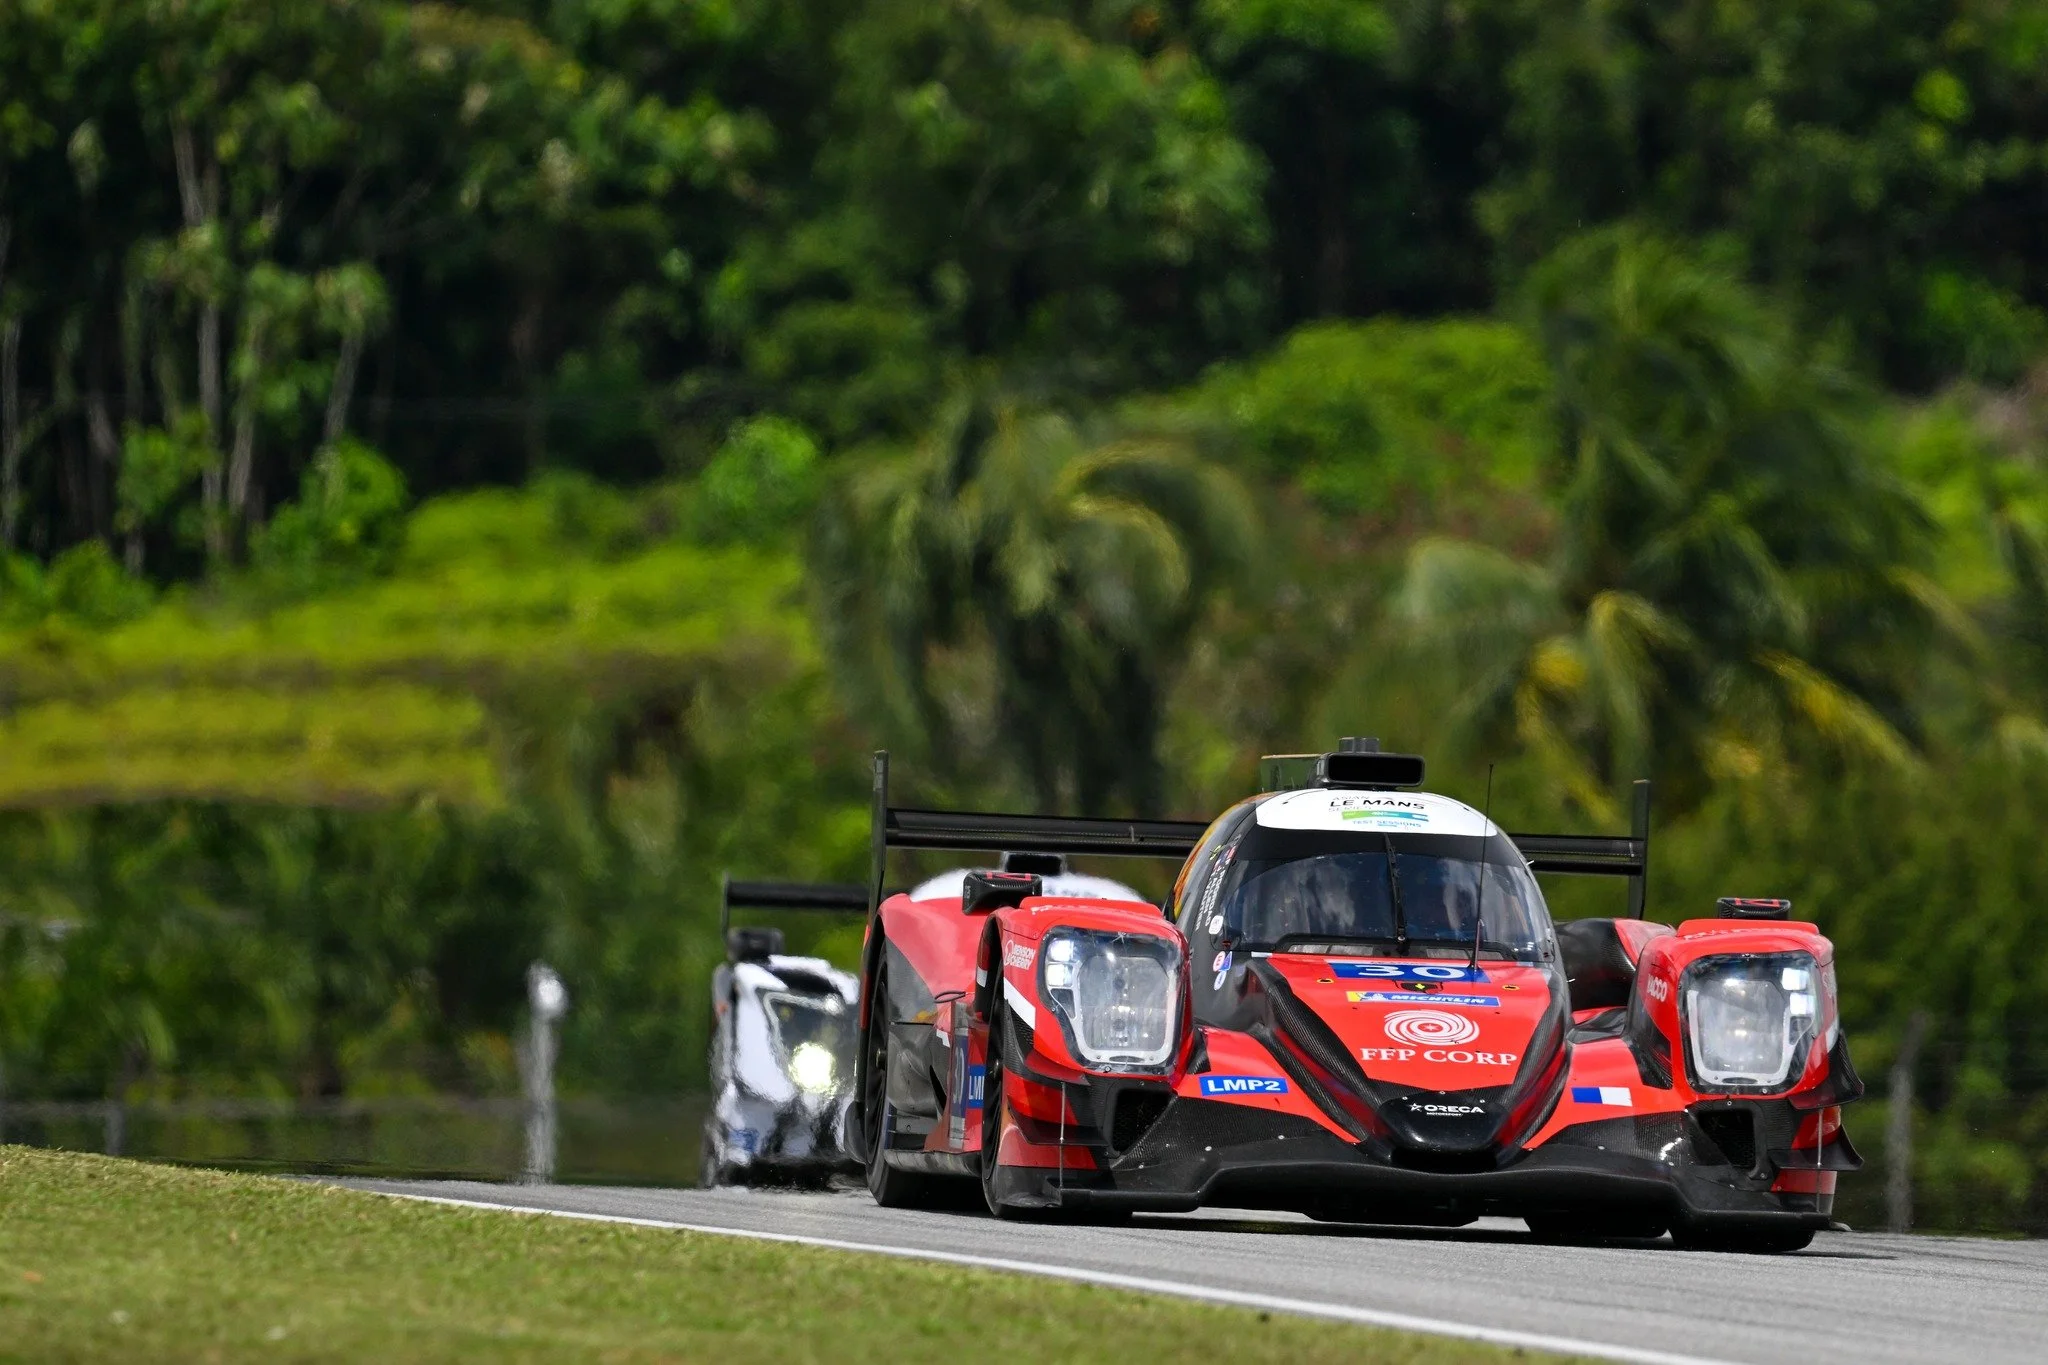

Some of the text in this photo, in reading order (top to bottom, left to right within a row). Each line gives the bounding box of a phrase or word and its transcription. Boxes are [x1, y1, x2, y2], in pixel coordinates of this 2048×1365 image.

[1363, 800, 1425, 810] MANS
[1355, 964, 1466, 979] 30
[1391, 994, 1486, 1004] MICHELIN
[1360, 1048, 1518, 1066] FFP CORP
[1207, 1079, 1281, 1092] LMP2
[1424, 1104, 1486, 1114] ORECA
